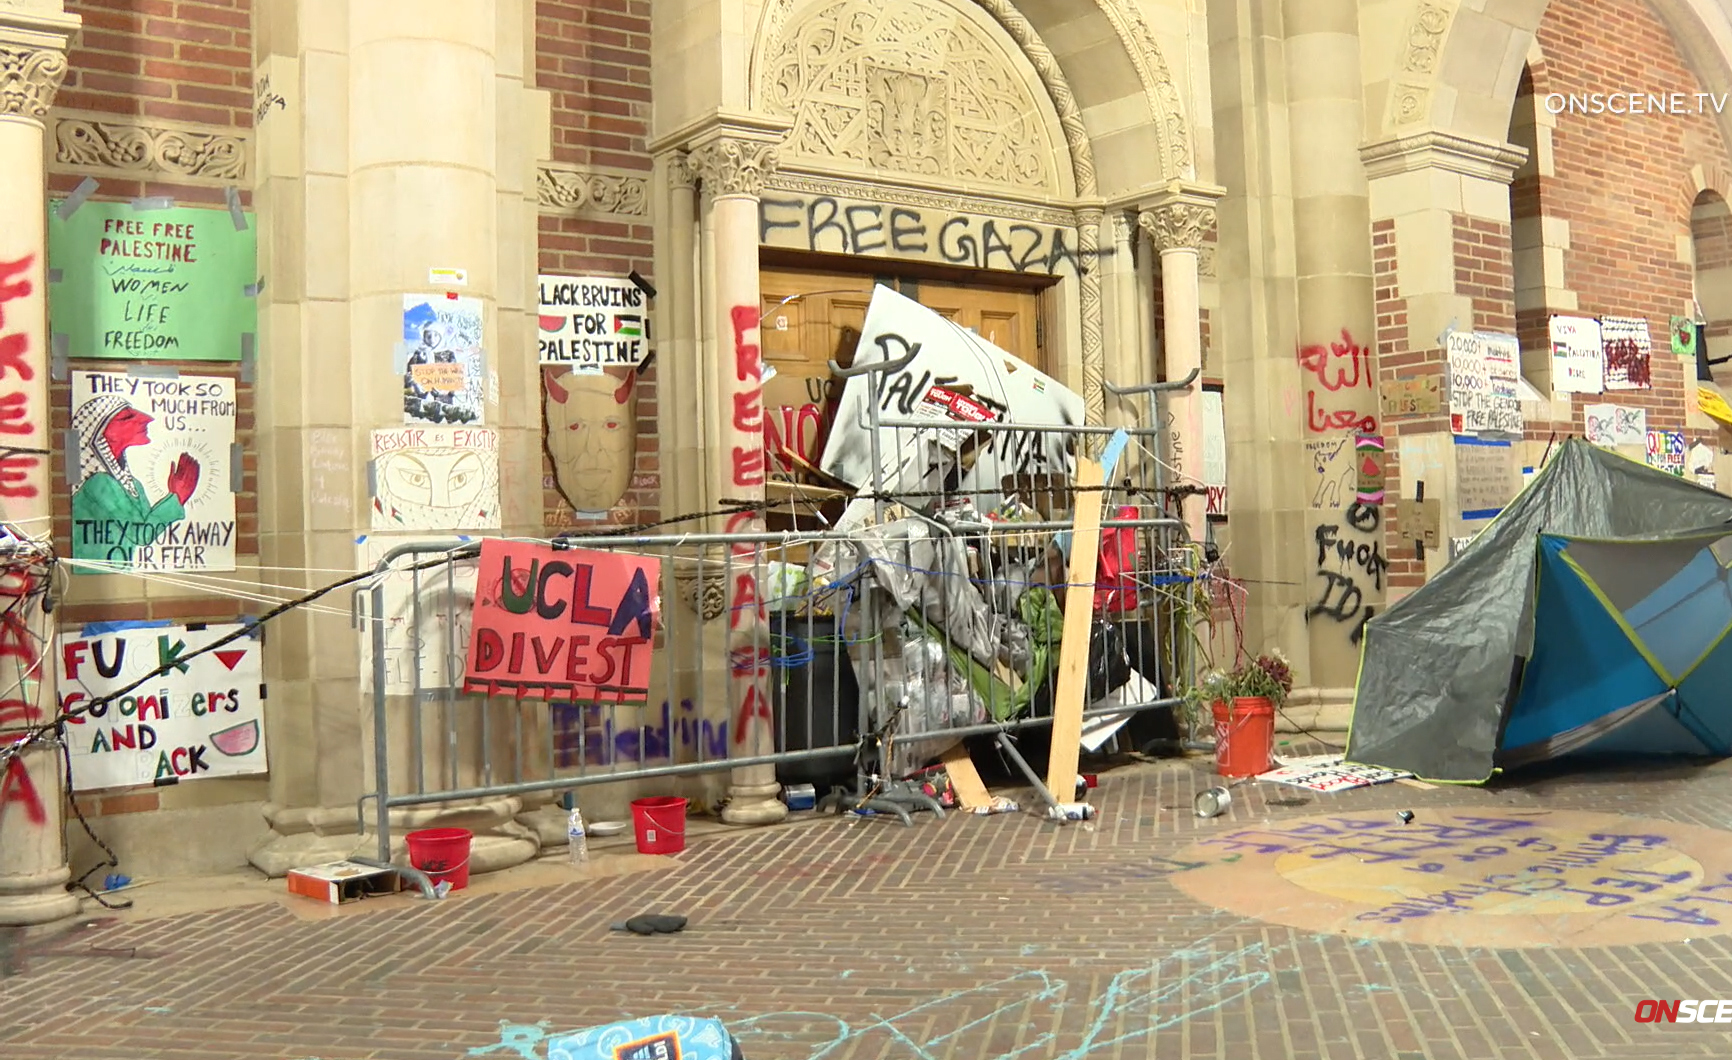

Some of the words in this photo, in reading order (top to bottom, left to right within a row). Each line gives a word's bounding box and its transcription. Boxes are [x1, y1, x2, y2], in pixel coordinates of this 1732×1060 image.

[104, 219, 144, 236] FREE
[152, 222, 195, 240] FREE
[760, 198, 929, 254] FREE
[938, 216, 1112, 276] GAZA
[100, 238, 197, 263] PALESTINE
[111, 278, 189, 296] WOMEN
[538, 283, 580, 306] LACK
[581, 285, 642, 307] BRUINS
[124, 300, 170, 324] LIFE
[573, 312, 607, 335] FOR
[104, 331, 180, 350] FREEDOM
[539, 338, 642, 363] PALESTINE
[86, 374, 139, 396] THEY
[142, 380, 189, 397] TOOK
[195, 382, 223, 397] SO
[731, 305, 763, 487] FREE
[151, 398, 198, 415] MUCH
[201, 400, 236, 417] FROM
[374, 429, 429, 452] RESISTIR
[453, 429, 497, 451] EXISTIR
[75, 519, 130, 546] THEY
[130, 521, 182, 547] TOOK
[183, 521, 235, 547] AWAY
[106, 545, 159, 571] OUR
[161, 545, 207, 570] FEAR
[503, 555, 651, 640] UCLA
[475, 627, 649, 687] DIVEST
